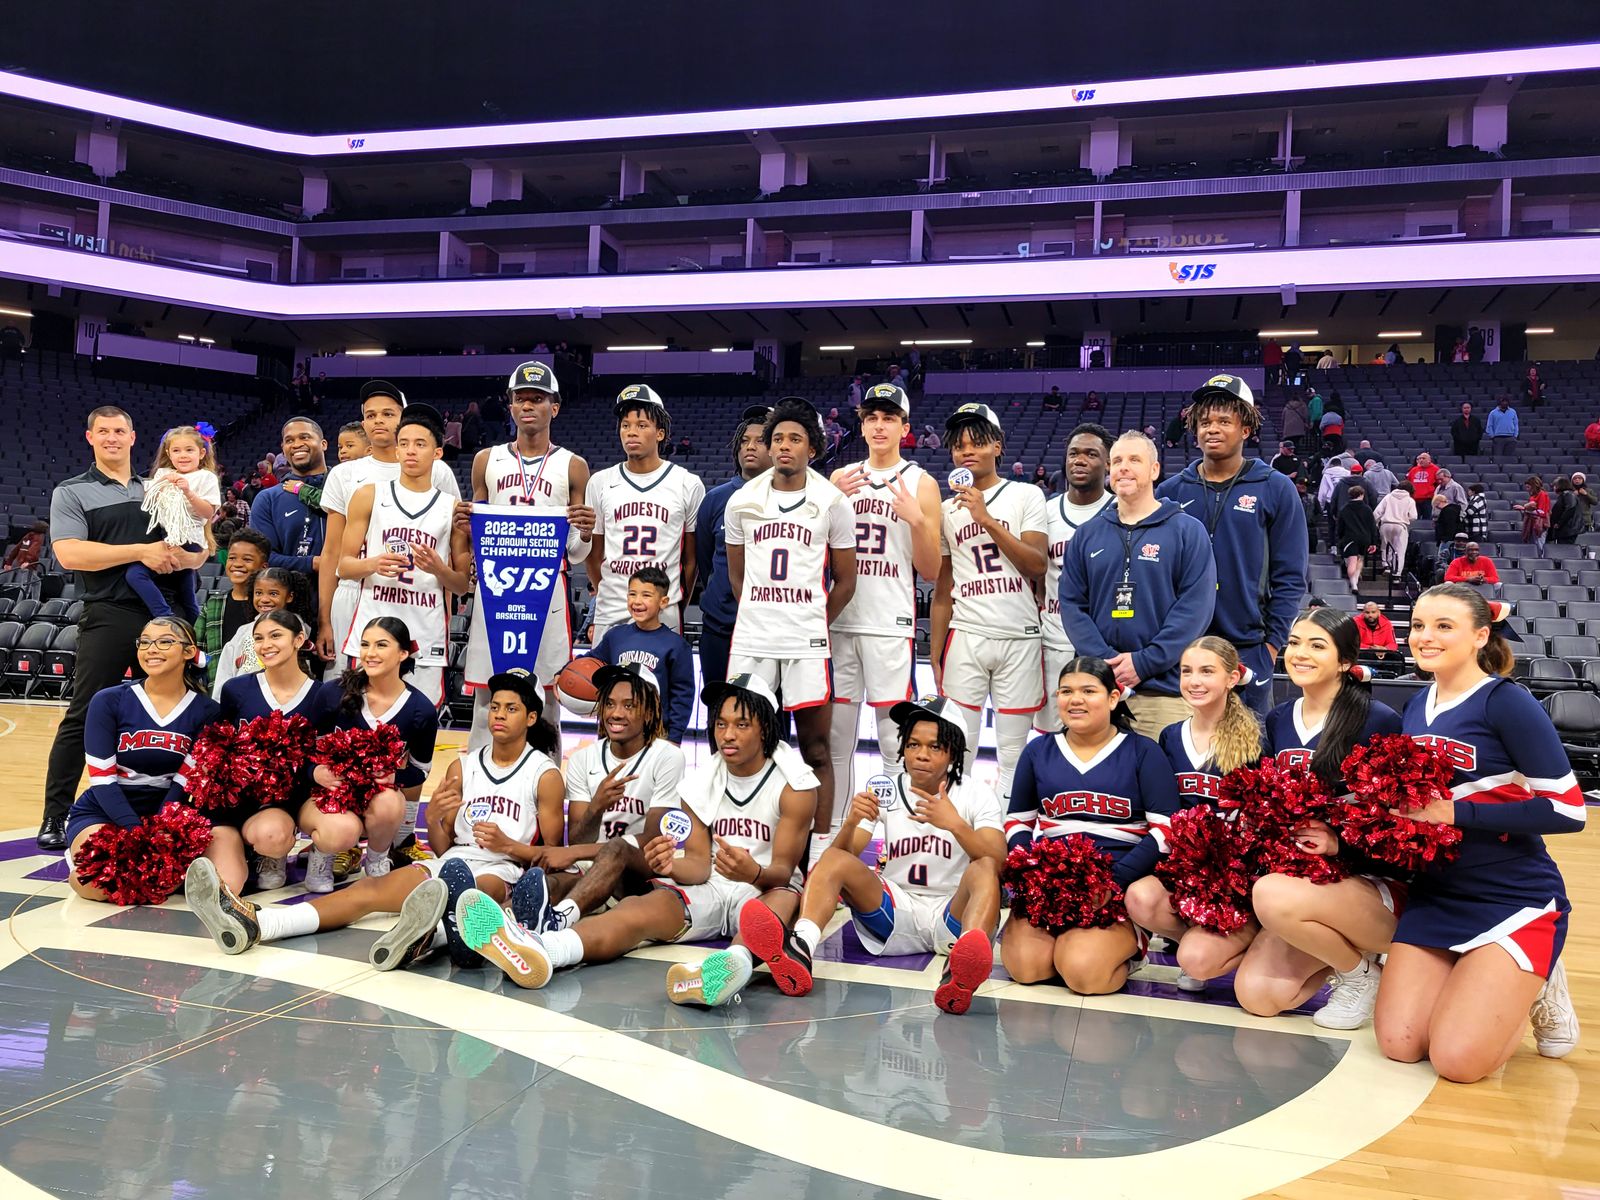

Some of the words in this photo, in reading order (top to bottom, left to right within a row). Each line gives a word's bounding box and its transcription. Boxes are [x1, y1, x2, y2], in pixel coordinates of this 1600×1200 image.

[1077, 89, 1096, 101] SJS
[351, 138, 365, 148] SJS
[1178, 263, 1218, 281] SJS
[614, 501, 669, 525] MODESTO
[852, 497, 898, 523] ODESTO
[484, 520, 556, 538] 2022-2023
[622, 525, 658, 557] 22
[753, 522, 812, 548] MODESTO
[855, 522, 887, 555] 23
[955, 518, 1010, 547] MODO
[480, 536, 495, 547] SAC
[496, 537, 528, 548] JOAQUIN
[529, 538, 560, 549] SECTION
[480, 546, 558, 558] CHAMPIONS
[769, 548, 789, 581] 0
[855, 559, 900, 579] ISTIAN
[971, 542, 1003, 575] 12
[497, 566, 555, 593] SJS
[960, 576, 1023, 598] CHRISTIAN
[373, 585, 437, 609] CHRISTIAN
[751, 585, 813, 604] CHRISTIAN
[495, 611, 538, 621] BASKETBALL
[507, 604, 526, 612] BOYS
[502, 630, 528, 655] D1
[118, 729, 193, 757] MCHS
[1411, 734, 1477, 772] HS
[873, 787, 894, 799] SJS
[1175, 771, 1221, 800] CH
[465, 795, 522, 823] ESTO
[471, 809, 489, 819] SJS
[606, 796, 646, 816] ESTO
[1041, 790, 1132, 819] MCHS
[665, 821, 690, 836] SJS
